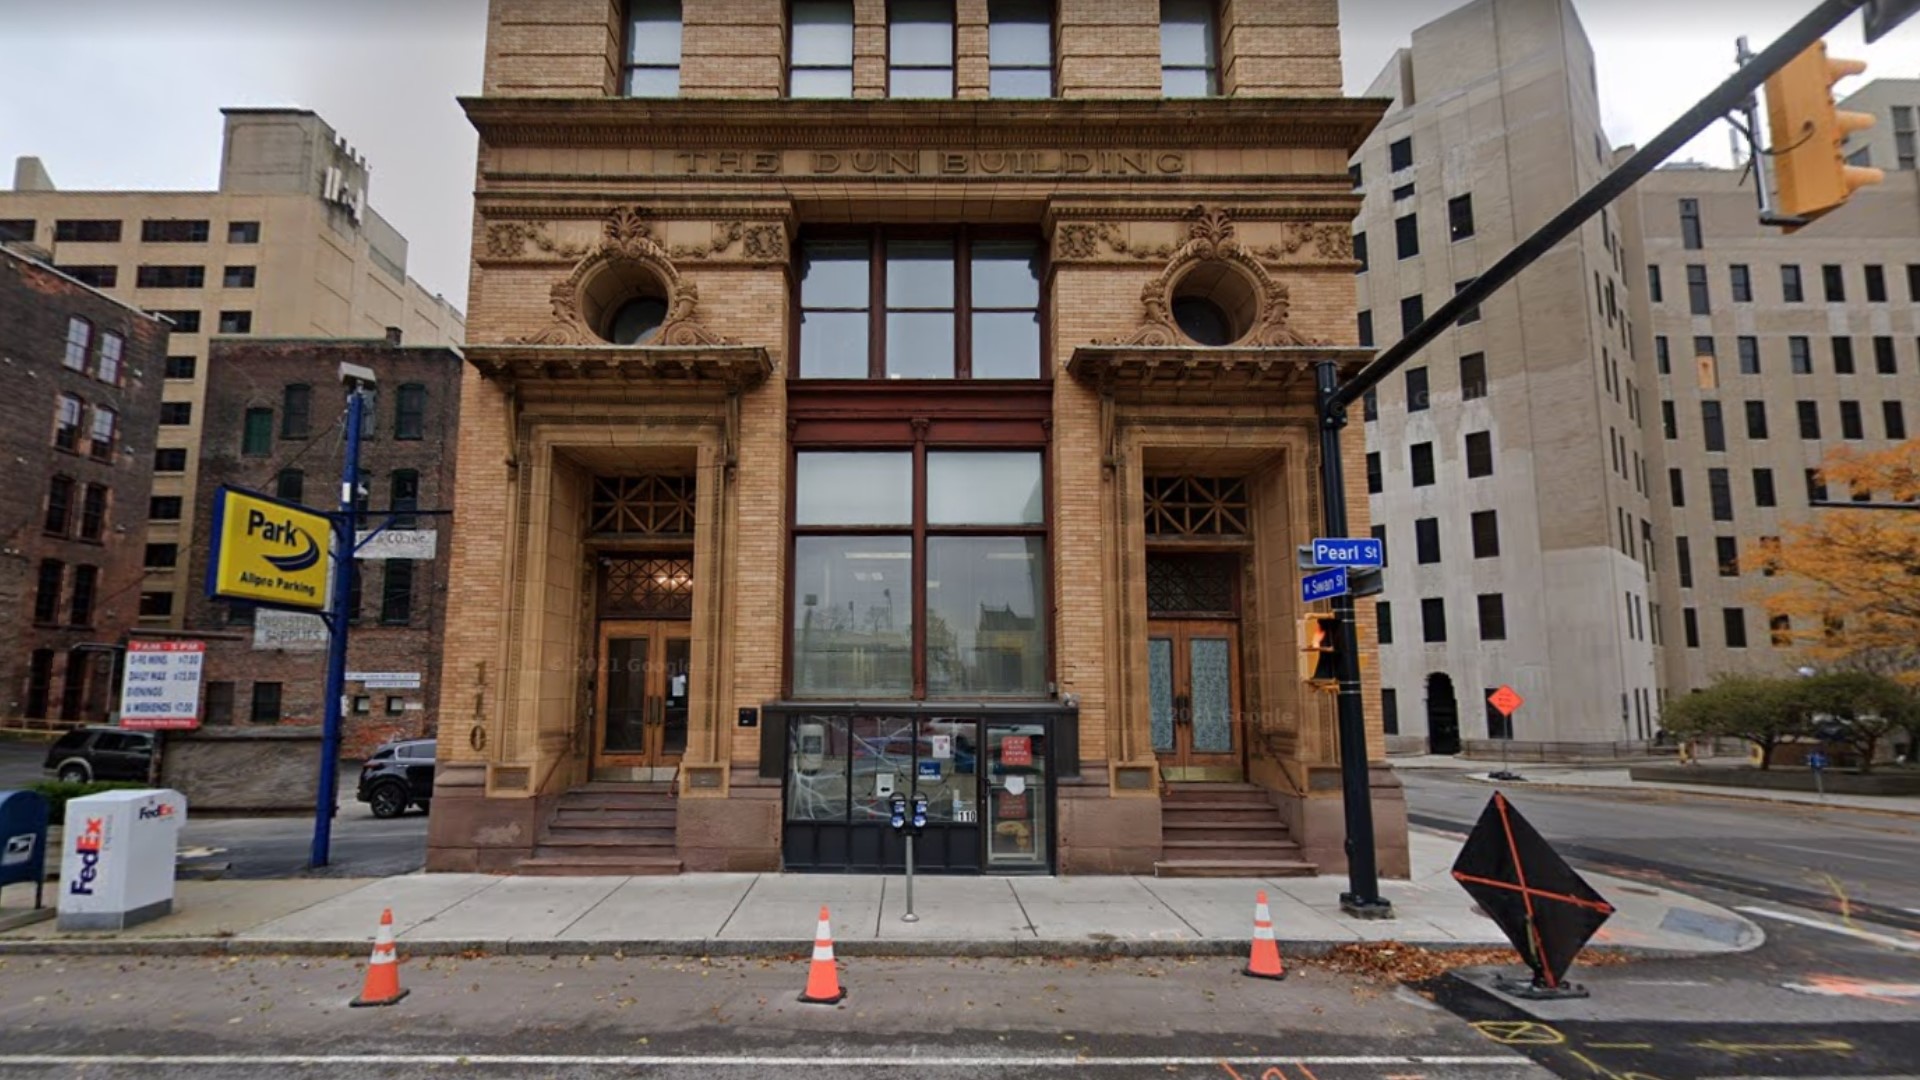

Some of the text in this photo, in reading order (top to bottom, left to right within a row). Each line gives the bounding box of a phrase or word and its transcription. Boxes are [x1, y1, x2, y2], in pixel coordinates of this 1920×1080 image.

[679, 152, 1185, 174] THE DUN BUILDING
[247, 509, 297, 547] Park
[1317, 544, 1378, 560] Pearl St
[240, 571, 316, 597] Allpro Parking
[1312, 576, 1335, 594] Swan
[1336, 574, 1344, 587] St
[139, 803, 175, 820] FedEx
[959, 811, 977, 822] 110
[70, 817, 104, 895] FedEx
